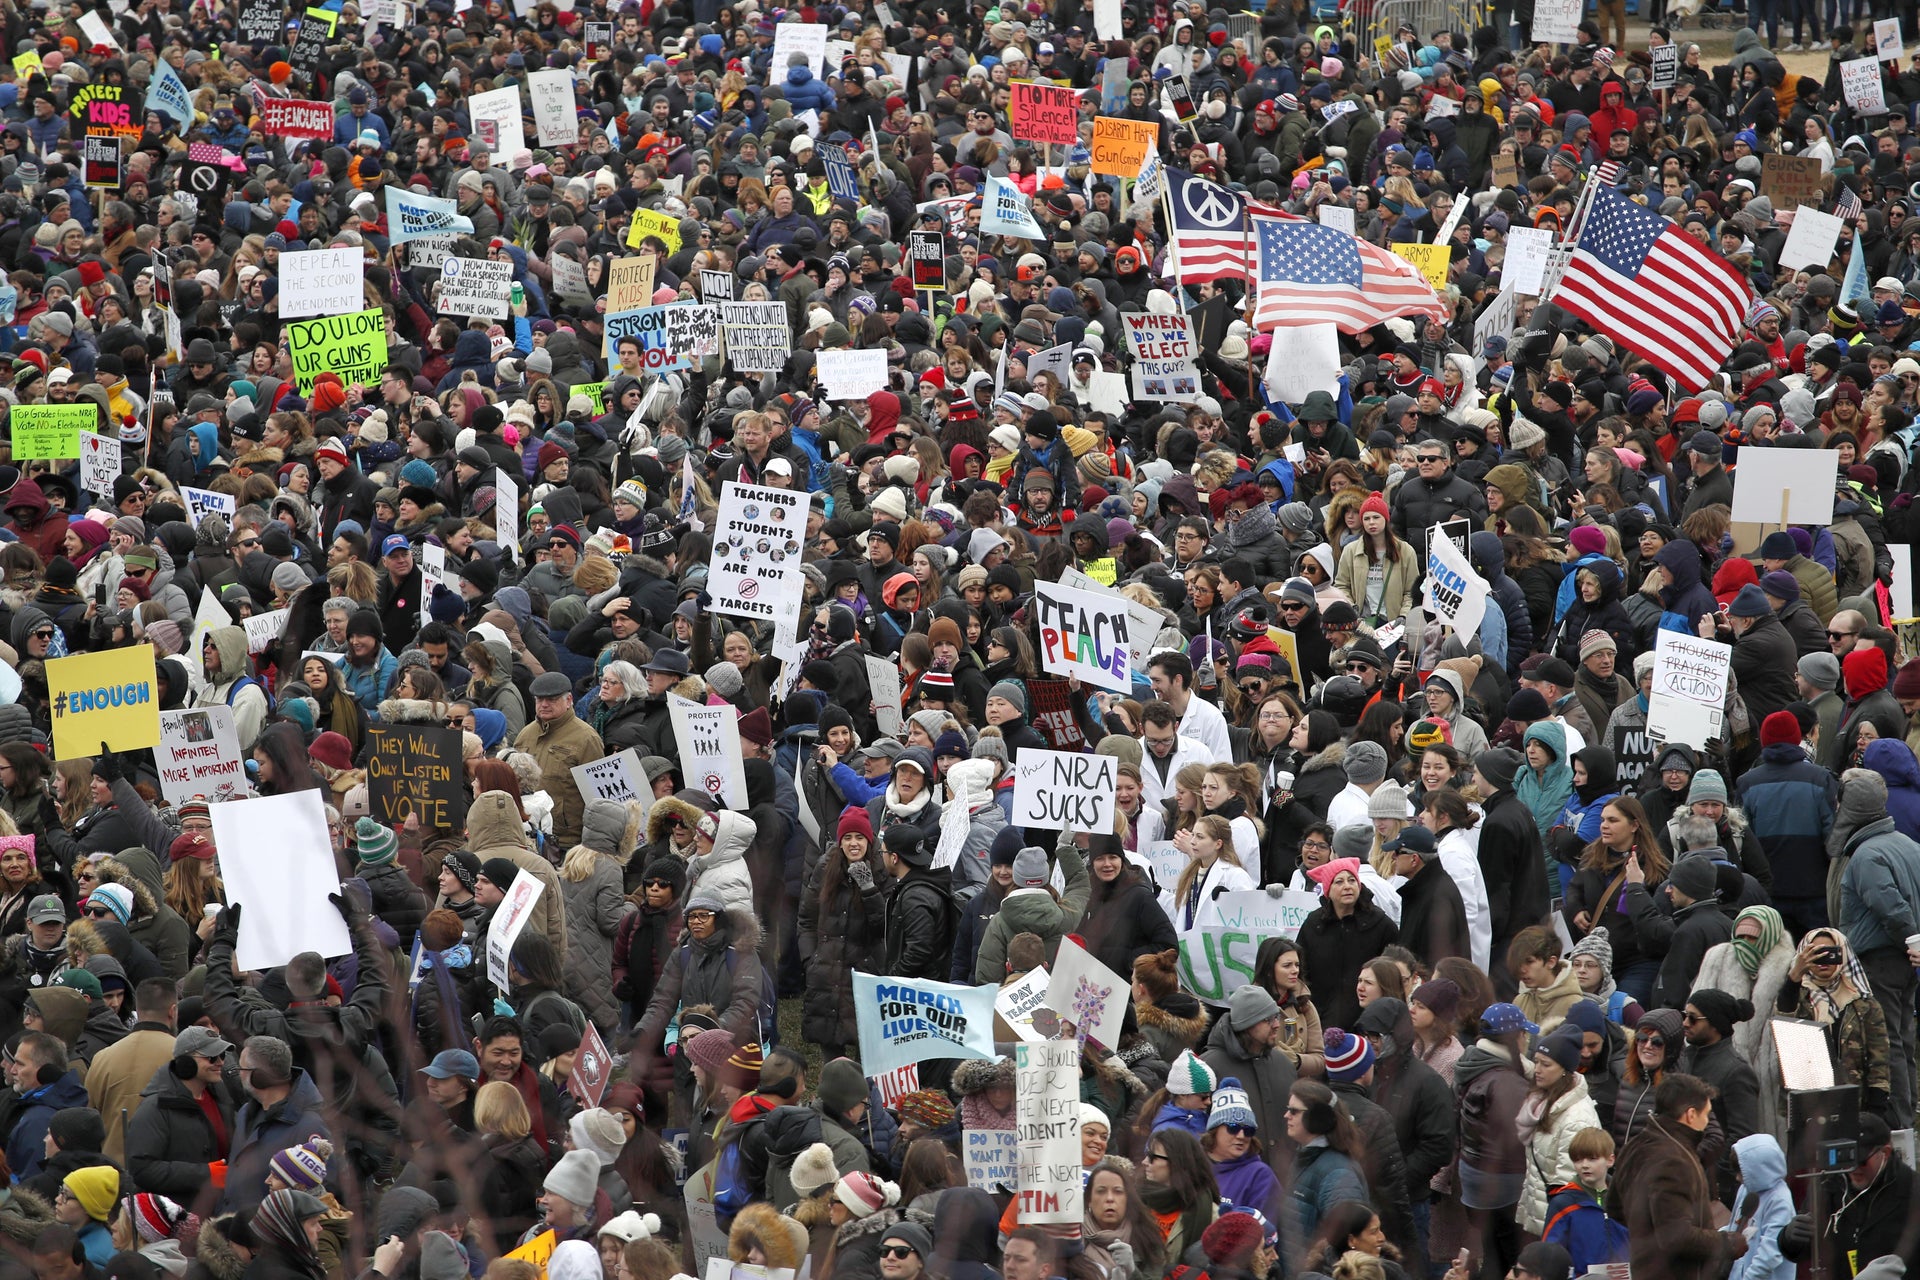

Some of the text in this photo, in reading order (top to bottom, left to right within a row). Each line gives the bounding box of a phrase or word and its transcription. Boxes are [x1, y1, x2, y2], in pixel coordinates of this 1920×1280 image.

[242, 9, 282, 20] ASSAULT
[255, 2, 269, 11] the
[238, 19, 281, 31] WEAPONS
[248, 29, 274, 41] BAN!
[300, 28, 326, 42] LESSON
[1861, 63, 1876, 73] are
[159, 82, 177, 94] FOR
[537, 83, 563, 94] The Time
[1848, 89, 1879, 101] waiting
[69, 84, 122, 118] PROTECT
[156, 90, 181, 107] LIVES
[1857, 98, 1879, 110] FOR
[88, 101, 130, 125] KIDS
[267, 104, 331, 132] #ENOUGH
[545, 124, 578, 143] Yesterday
[1014, 123, 1047, 139] End Gun
[88, 139, 101, 147] THE
[88, 146, 117, 154] SYSTEM
[822, 160, 860, 199] LOVE
[1776, 171, 1813, 184] KILL
[998, 198, 1016, 209] FOR
[401, 213, 422, 225] FOR
[635, 211, 676, 236] KIDS NOT
[997, 209, 1023, 223] LIVES
[403, 224, 438, 234] LIVES
[410, 239, 430, 249] MANY
[913, 235, 925, 243] THE
[913, 242, 940, 251] SYSTEM
[289, 252, 350, 272] REPEAL
[410, 251, 435, 265] AS A
[1404, 247, 1432, 263] ARMS
[444, 258, 508, 276] Q HOW MANY
[462, 270, 512, 282] NRA SPOKESMEN
[610, 263, 652, 286] PROTECT
[286, 273, 356, 290] THE SECOND
[442, 277, 499, 290] ARE NEEDED TO
[702, 273, 731, 297] NO!
[440, 286, 477, 298] CHANGE A
[617, 285, 643, 305] KIDS
[287, 296, 355, 311] AMENDMENT
[440, 298, 500, 316] A MORE GUNS
[725, 304, 785, 325] CITIZENS UNITED
[1127, 316, 1187, 330] WHEN
[291, 314, 385, 350] DO U LOVE
[744, 327, 787, 348] FREE SPEECH
[1133, 330, 1186, 343] DID WE
[295, 343, 371, 373] UR GUNS
[746, 349, 762, 368] OPEN
[762, 349, 788, 369] SEASON
[1138, 341, 1189, 360] ELECT
[342, 366, 373, 386] THEM
[1138, 360, 1185, 375] THIS GUY?
[31, 407, 56, 419] Grades
[57, 409, 69, 417] from
[79, 408, 97, 418] NRA?
[16, 420, 36, 431] Vote
[36, 420, 50, 430] NO
[57, 420, 79, 430] Election
[80, 421, 95, 432] Day!
[86, 454, 118, 471] OUR KIDS
[93, 468, 111, 480] NOT
[85, 477, 99, 491] Your
[734, 487, 797, 506] TEACHERS
[728, 520, 794, 540] STUDENTS
[723, 562, 784, 580] ARE NOT
[719, 597, 773, 615] TARGETS
[1037, 591, 1129, 643] TEACH
[247, 617, 268, 638] WHO
[1668, 640, 1729, 667] THOUGHTS
[1666, 656, 1718, 681] PRAYERS
[1670, 673, 1717, 697] ACTION
[53, 681, 150, 718] #ENOUGH
[688, 711, 722, 720] PROTECT
[162, 713, 223, 740] family is
[170, 744, 220, 762] INFINITELY
[368, 729, 441, 759] THEY WILL
[163, 760, 239, 783] MORE IMPORTANT
[370, 756, 450, 782] ONLY LISTEN
[585, 757, 623, 774] PROTECT
[1020, 755, 1113, 793] the NRA
[393, 779, 430, 797] IF WE
[382, 794, 451, 827] VOTE
[1029, 788, 1103, 829] SUCKS
[1216, 906, 1277, 928] We need
[876, 984, 964, 1015] MARCH
[1008, 983, 1033, 1004] PAY
[879, 1001, 968, 1034] FOR OUR
[893, 1031, 928, 1046] #NEVER
[1037, 1046, 1078, 1068] SHOULD
[1041, 1098, 1077, 1118] NEXT
[969, 1133, 987, 1146] DO
[970, 1149, 1003, 1163] WANT
[970, 1165, 1018, 1180] TO HAVE
[1048, 1164, 1081, 1184] NEXT
